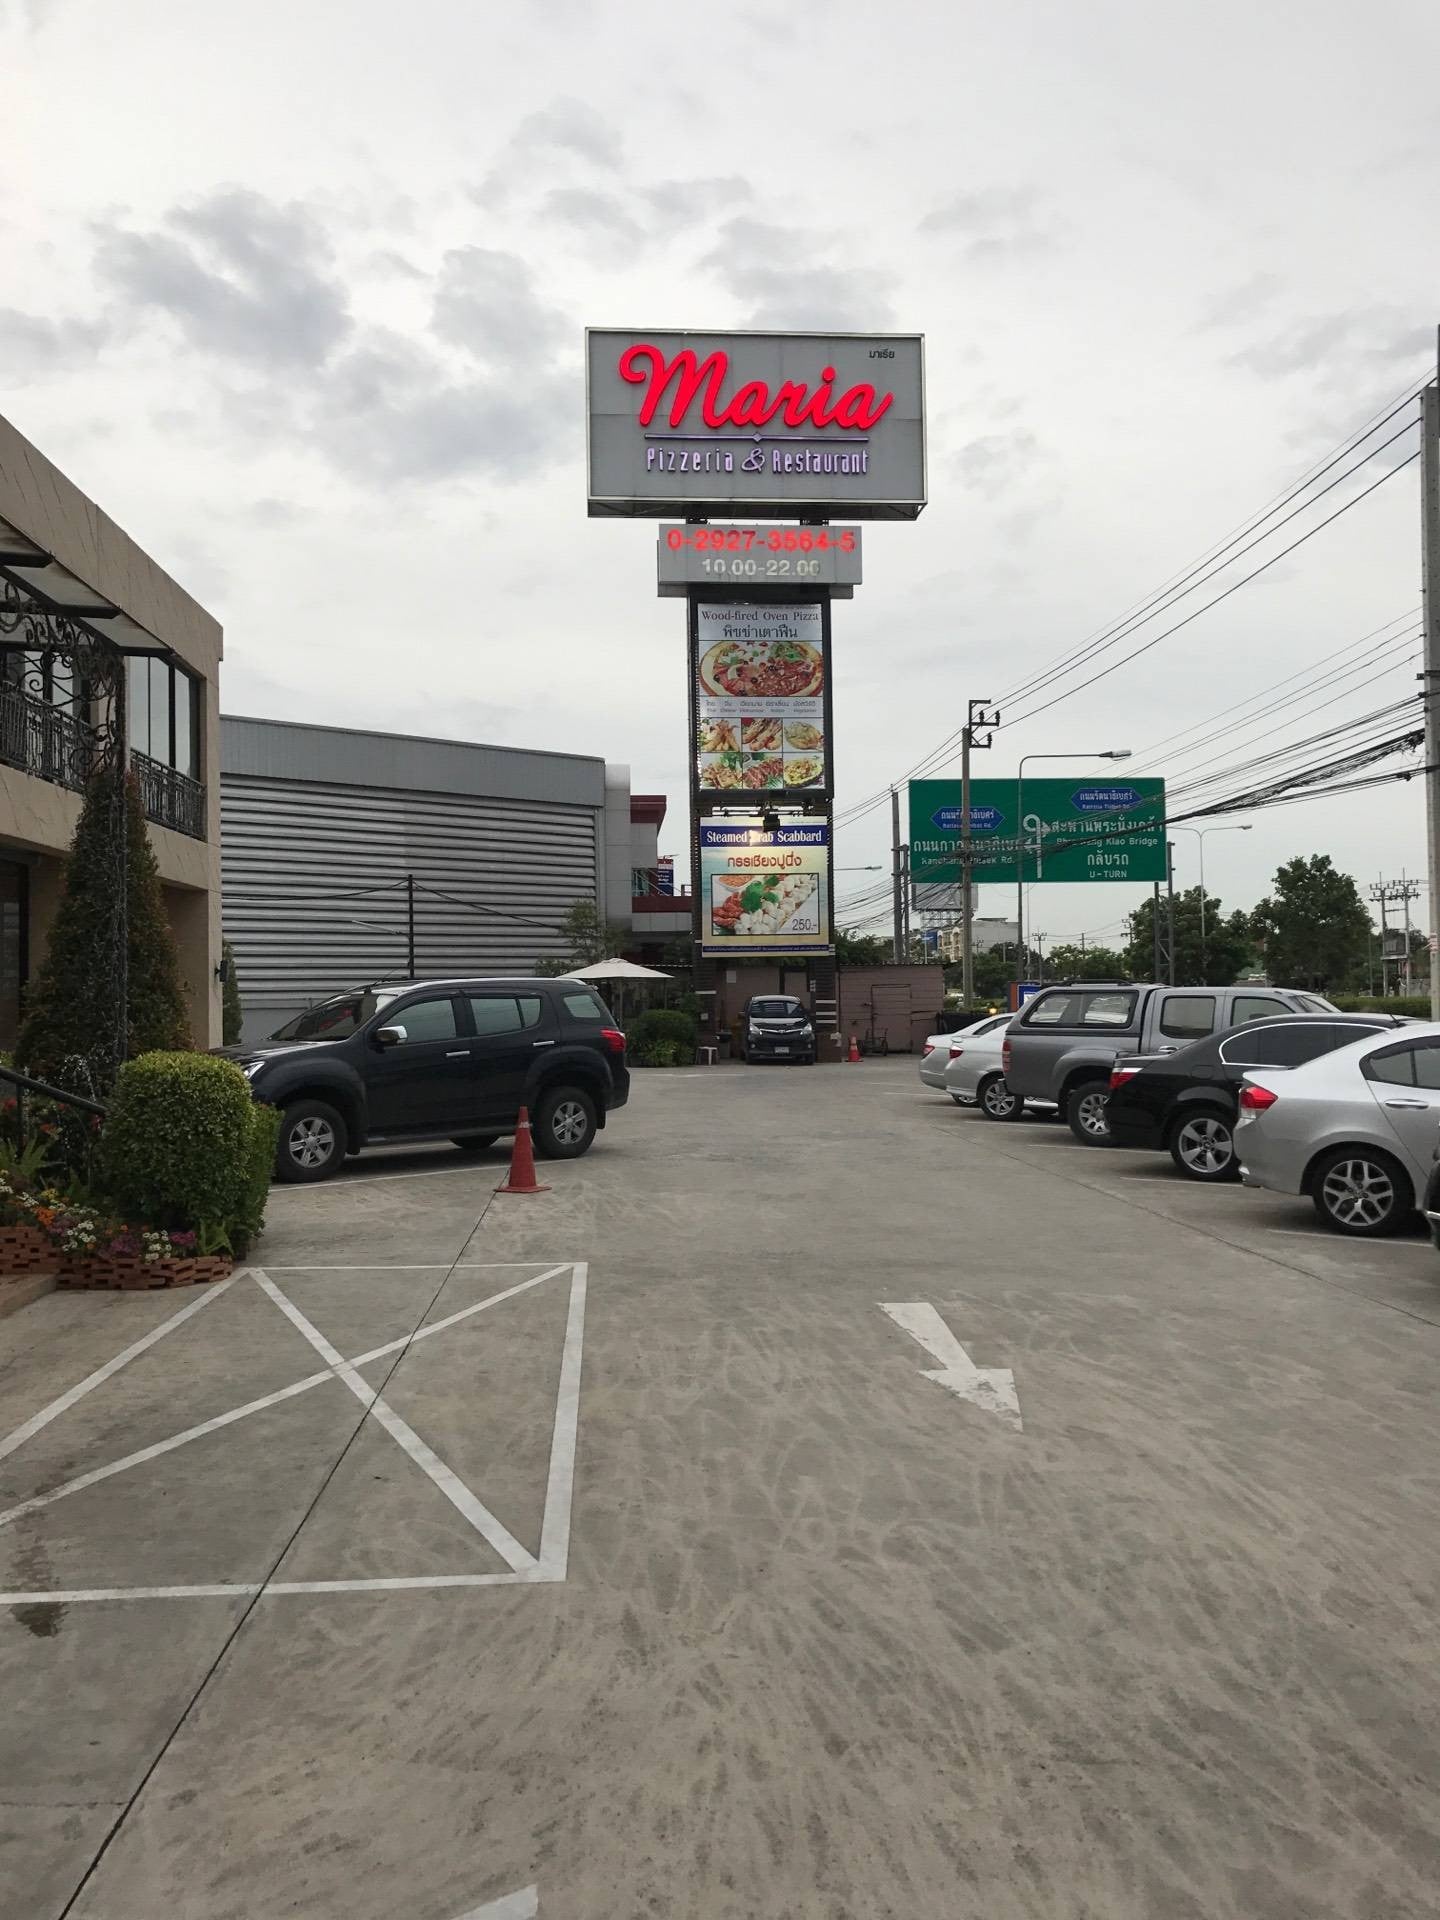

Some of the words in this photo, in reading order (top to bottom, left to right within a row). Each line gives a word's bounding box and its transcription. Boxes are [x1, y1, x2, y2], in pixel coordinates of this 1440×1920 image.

[868, 348, 895, 359] มาเรีย
[618, 344, 894, 430] Maria
[646, 448, 734, 473] Pizzeria
[741, 447, 766, 473] &
[772, 449, 869, 475] Restaurant
[701, 558, 820, 577] 10.00-22.00
[701, 610, 758, 621] Wood-fired
[763, 611, 788, 621] Oven
[793, 611, 819, 621] Pizza
[706, 830, 747, 843] Steamed
[777, 829, 822, 843] Scabbard
[1129, 837, 1158, 847] Bridge
[1087, 849, 1129, 866] กลับรถ
